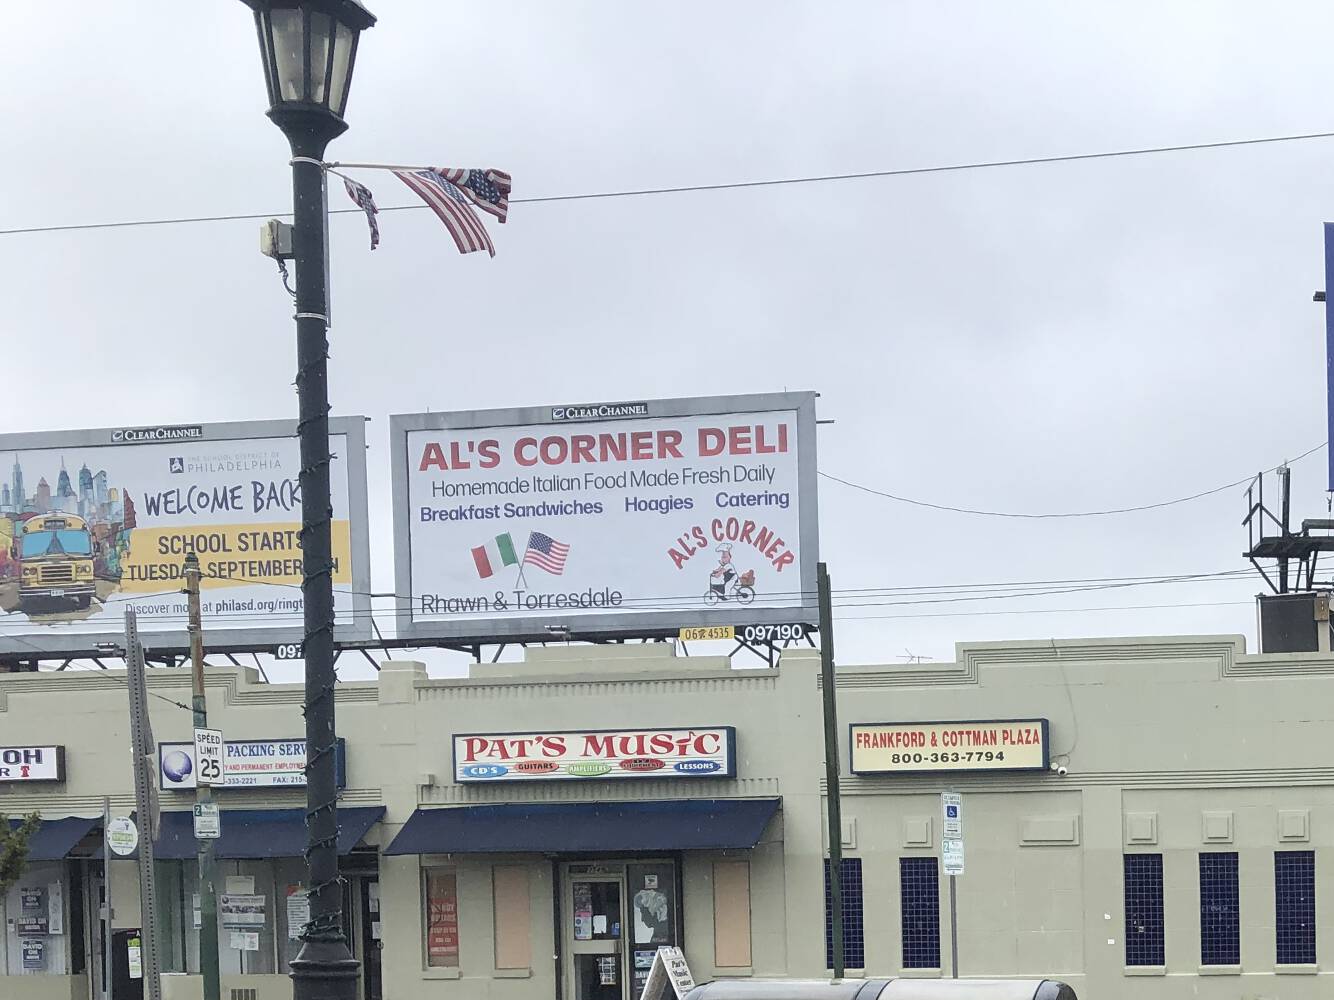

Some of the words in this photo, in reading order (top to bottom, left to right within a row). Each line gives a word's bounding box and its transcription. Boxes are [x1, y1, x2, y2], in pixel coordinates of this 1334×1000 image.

[418, 439, 501, 472] AL'S
[513, 429, 683, 467] CORNER
[697, 423, 789, 457] DELI
[187, 460, 281, 473] PHILADELPHIA
[432, 477, 529, 497] Homemade
[533, 475, 581, 492] Italian
[584, 471, 627, 490] Food
[630, 469, 679, 487] Made
[682, 466, 730, 485] Fresh
[734, 464, 776, 484] Daily
[144, 485, 244, 516] WELCOME
[251, 479, 302, 513] BACK
[420, 503, 500, 522] Breakfast
[504, 500, 604, 518] Sandwiches
[625, 495, 694, 514] Hoagies
[715, 491, 790, 509] Catering
[158, 533, 232, 555] SCHOOL
[667, 525, 708, 570] AL'S
[711, 517, 795, 572] CORNER
[128, 563, 192, 581] TUESDA
[207, 558, 303, 578] SEPTEMBER
[125, 602, 170, 614] Discover
[202, 602, 213, 612] at
[421, 594, 489, 613] Rhawn
[493, 591, 508, 611] &
[513, 587, 623, 610] Torresdale
[745, 624, 802, 640] 097190
[197, 733, 221, 745] SPEED
[463, 736, 567, 762] PAT'S
[856, 731, 926, 749] FRANKFORD
[930, 731, 938, 747] &
[942, 729, 998, 748] COTTMAN
[1002, 728, 1040, 746] PLAZA
[3, 748, 43, 765] OH
[200, 746, 218, 756] LIMIT
[227, 744, 275, 757] PACKING
[891, 751, 1005, 764] 800-363-7794
[201, 758, 220, 779] 25
[518, 762, 555, 770] GUITARS
[679, 762, 714, 770] LESSONS
